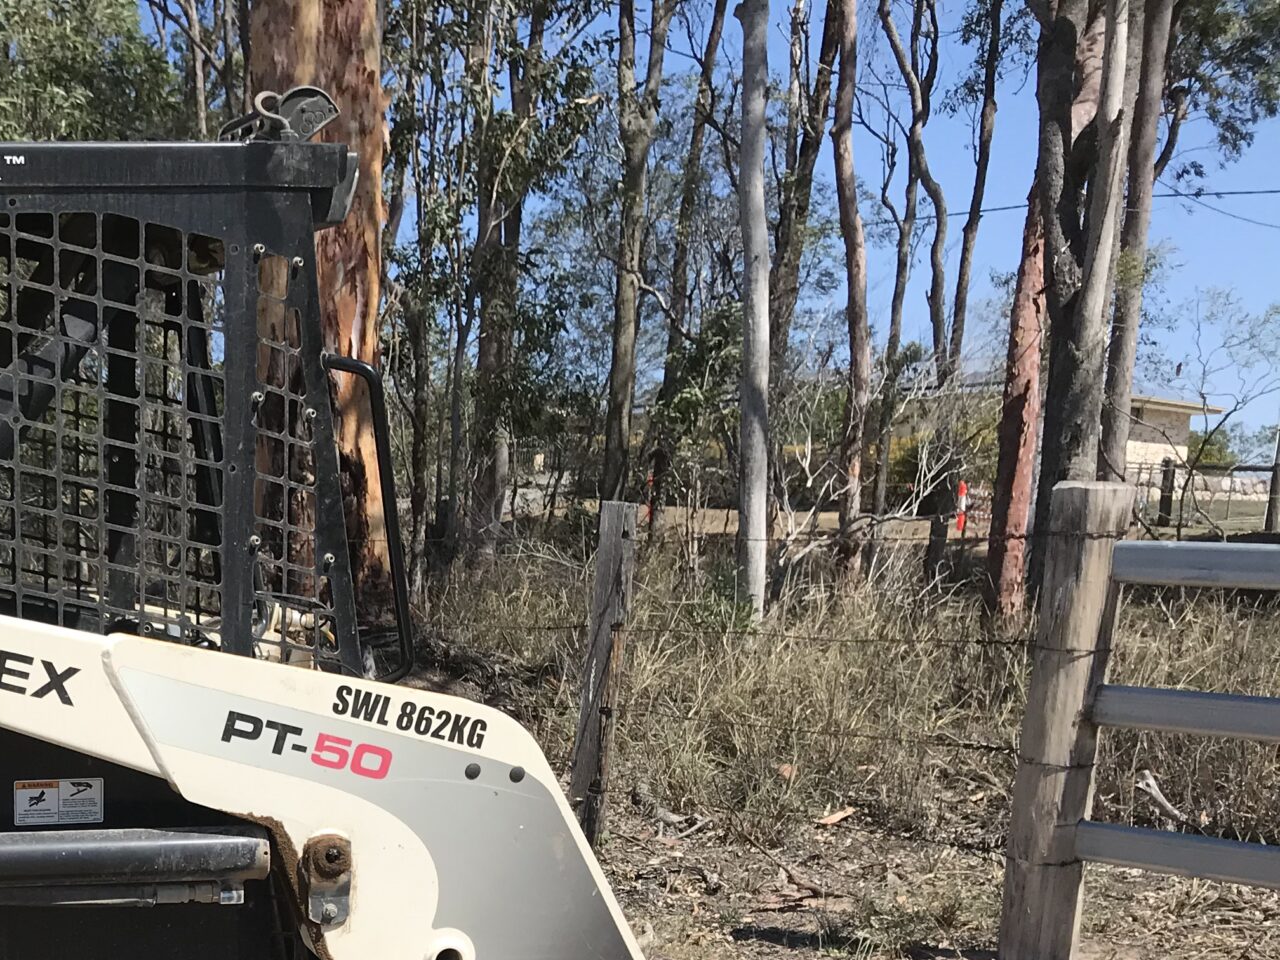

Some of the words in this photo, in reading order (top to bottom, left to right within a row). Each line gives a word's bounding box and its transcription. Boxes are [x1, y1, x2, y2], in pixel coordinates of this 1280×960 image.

[221, 710, 393, 780] PT-50
[332, 685, 391, 727] SWL
[396, 701, 487, 749] 862KG
